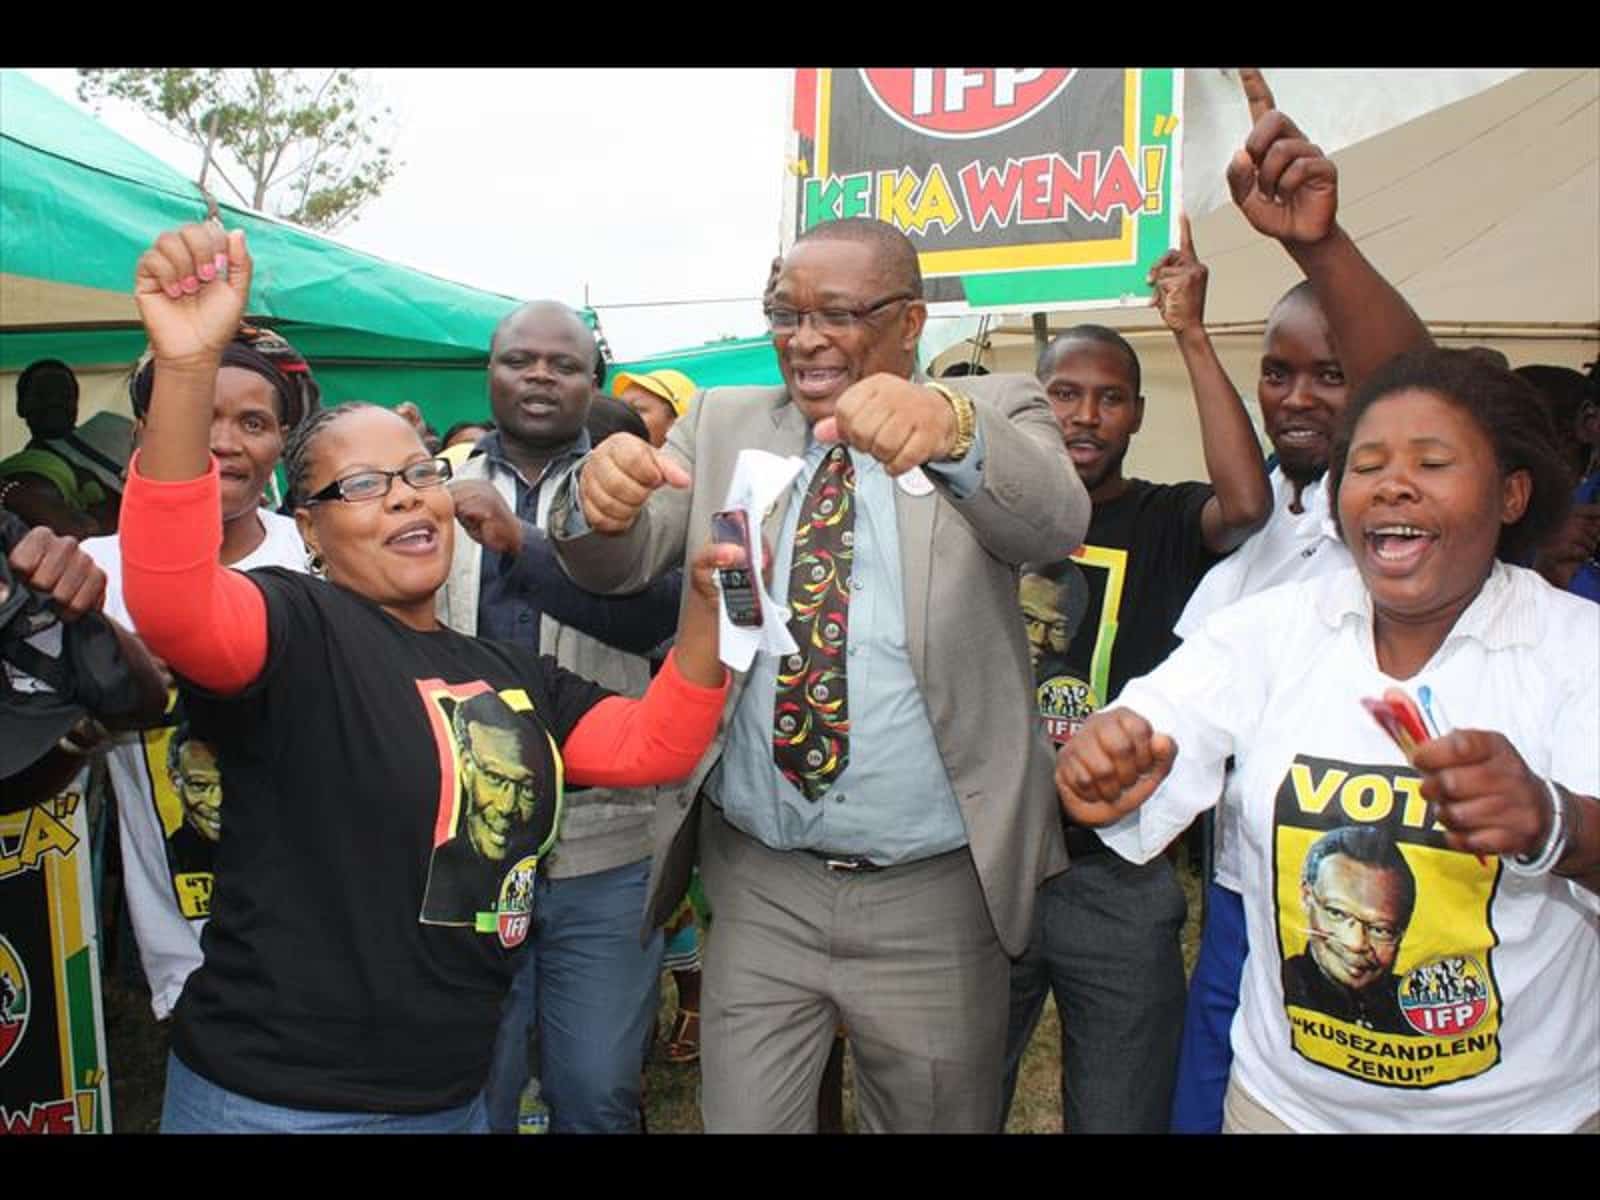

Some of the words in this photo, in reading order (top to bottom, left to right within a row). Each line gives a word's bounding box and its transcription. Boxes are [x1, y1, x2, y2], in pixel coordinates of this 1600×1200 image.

[876, 164, 963, 236] KA
[1291, 762, 1448, 832] VOT
[1424, 1004, 1474, 1030] IFP
